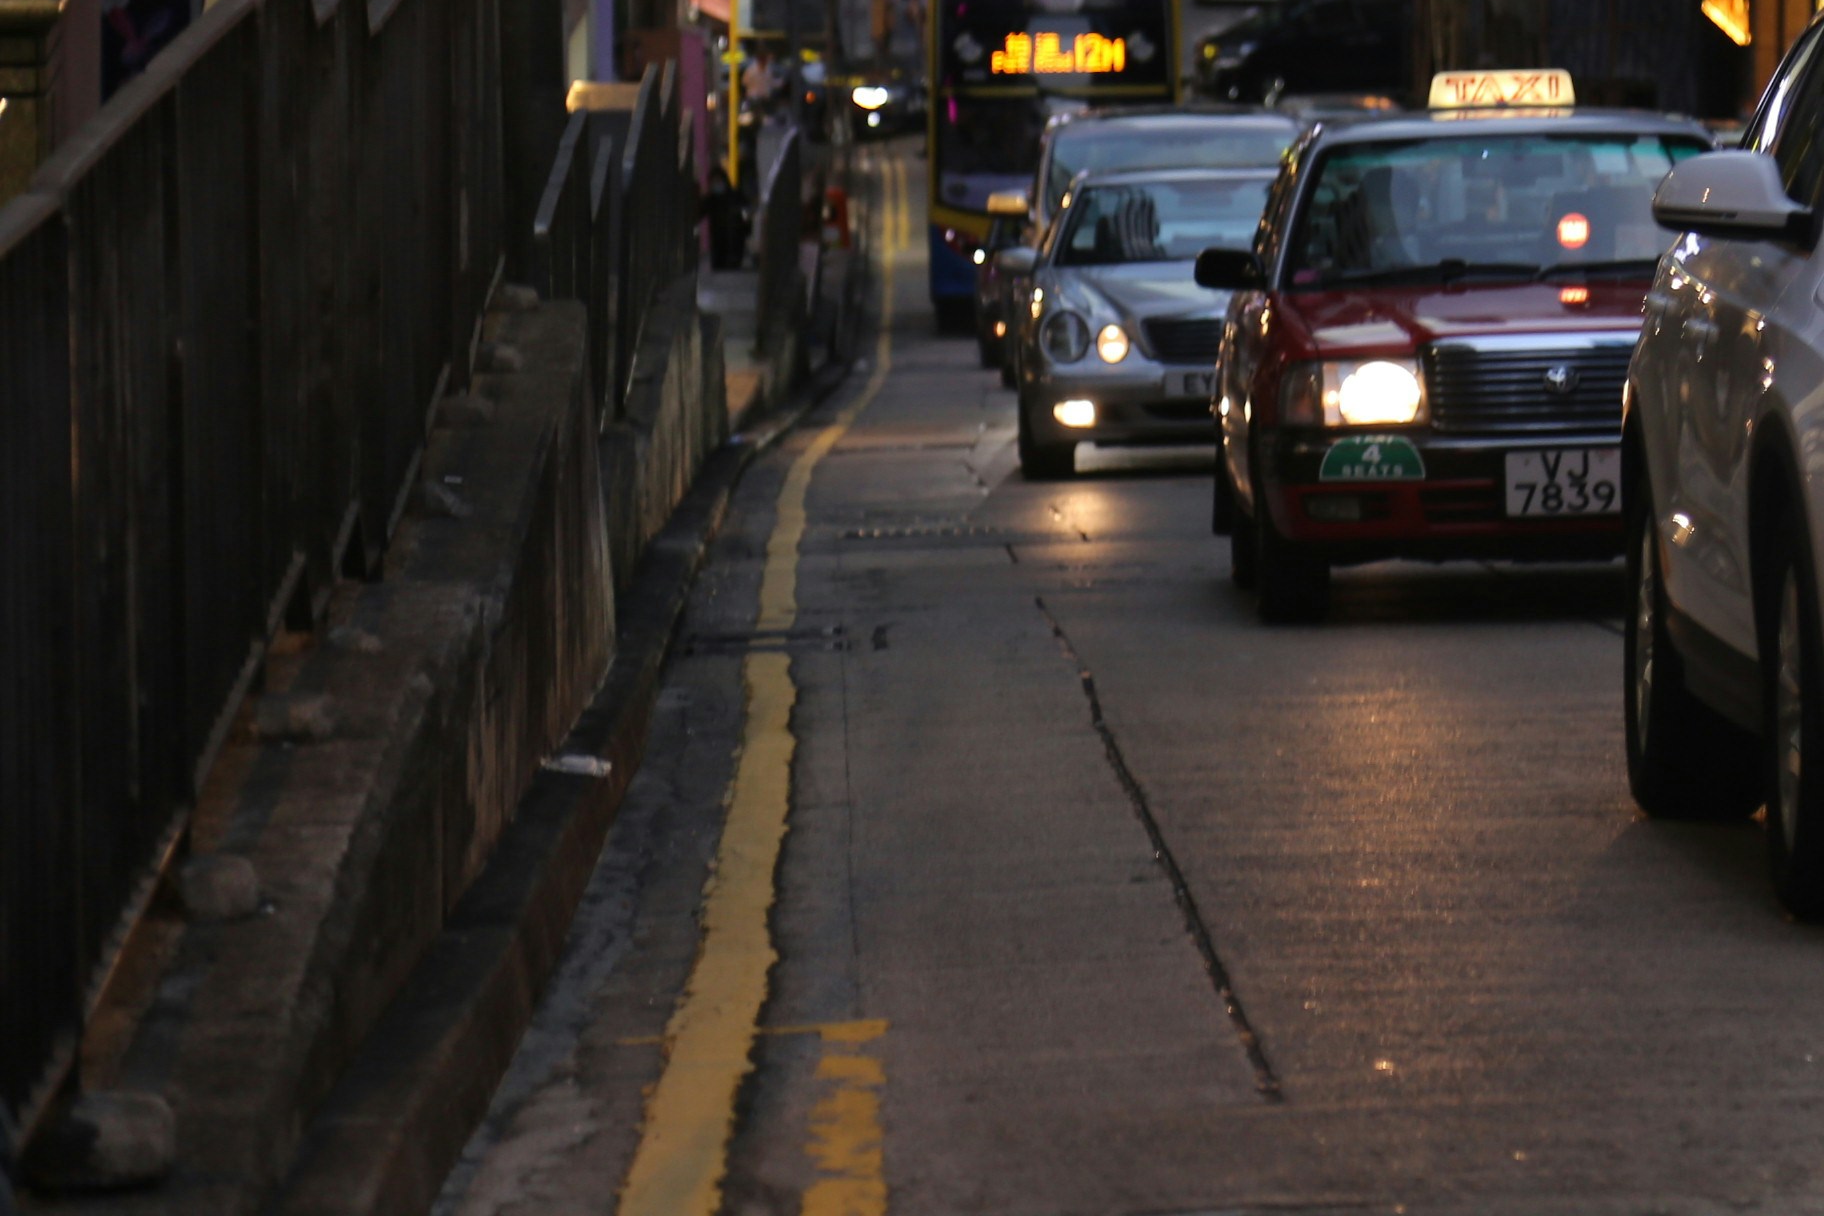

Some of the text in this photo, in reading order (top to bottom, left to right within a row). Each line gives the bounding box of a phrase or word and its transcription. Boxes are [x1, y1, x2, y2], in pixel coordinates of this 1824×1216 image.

[1445, 71, 1560, 104] TAXI
[1183, 373, 1213, 394] EY
[1361, 444, 1382, 465] 4
[1541, 449, 1590, 481] VJ
[1341, 465, 1403, 478] SEATS
[1514, 480, 1617, 515] 7839
